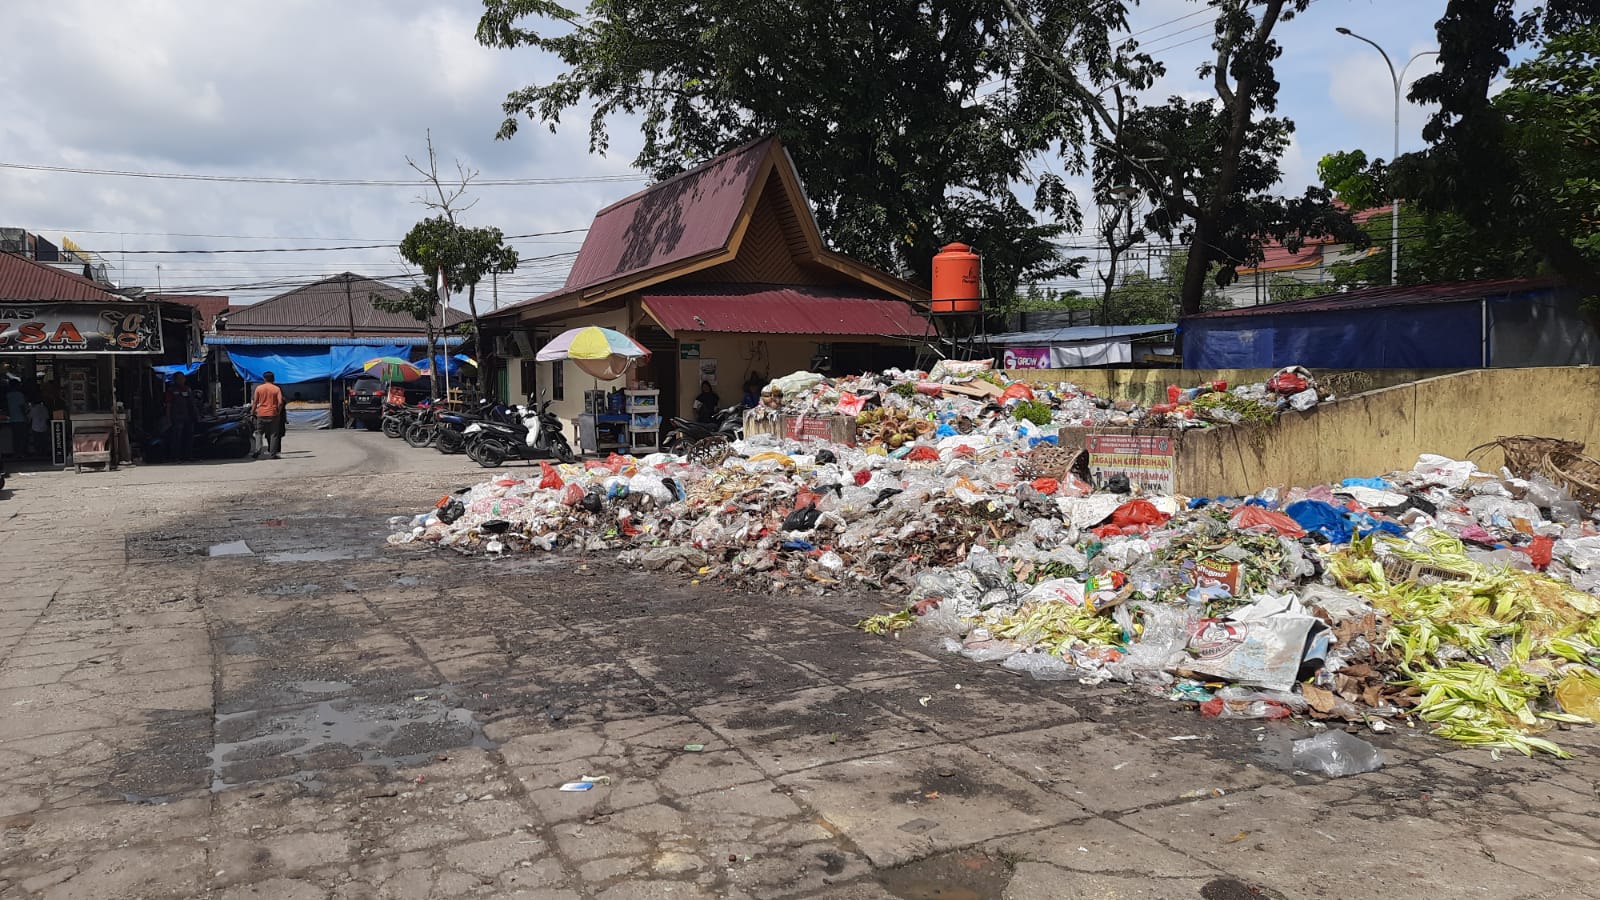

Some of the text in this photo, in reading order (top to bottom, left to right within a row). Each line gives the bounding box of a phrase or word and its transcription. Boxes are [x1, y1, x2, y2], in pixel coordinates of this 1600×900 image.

[1092, 456, 1168, 467] JAGALAH KEBERSIHAN
[1140, 472, 1169, 481] SAMPAH
